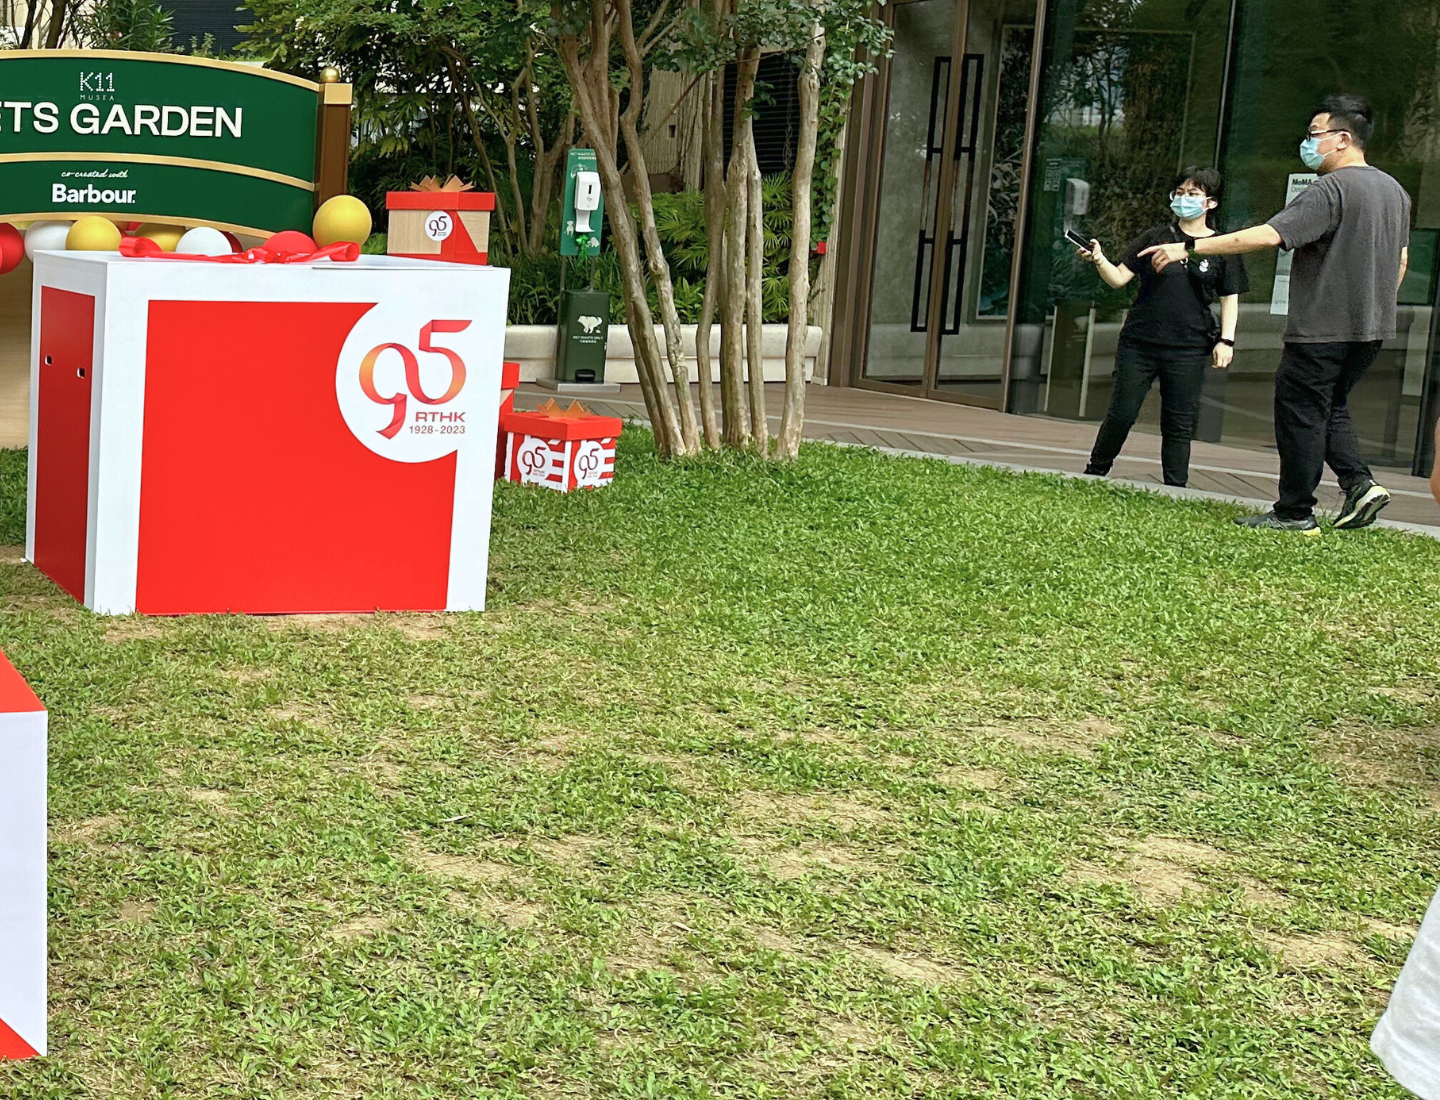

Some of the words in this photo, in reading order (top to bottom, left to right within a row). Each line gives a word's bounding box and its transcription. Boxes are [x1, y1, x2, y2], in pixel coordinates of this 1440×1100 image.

[79, 71, 115, 92] K11
[70, 103, 243, 138] GARDEN
[61, 168, 109, 178] co-created
[108, 169, 129, 178] with
[428, 215, 448, 237] 95
[359, 319, 473, 440] 95
[415, 411, 466, 423] RTHK
[522, 446, 547, 476] 95
[578, 447, 600, 480] 95
